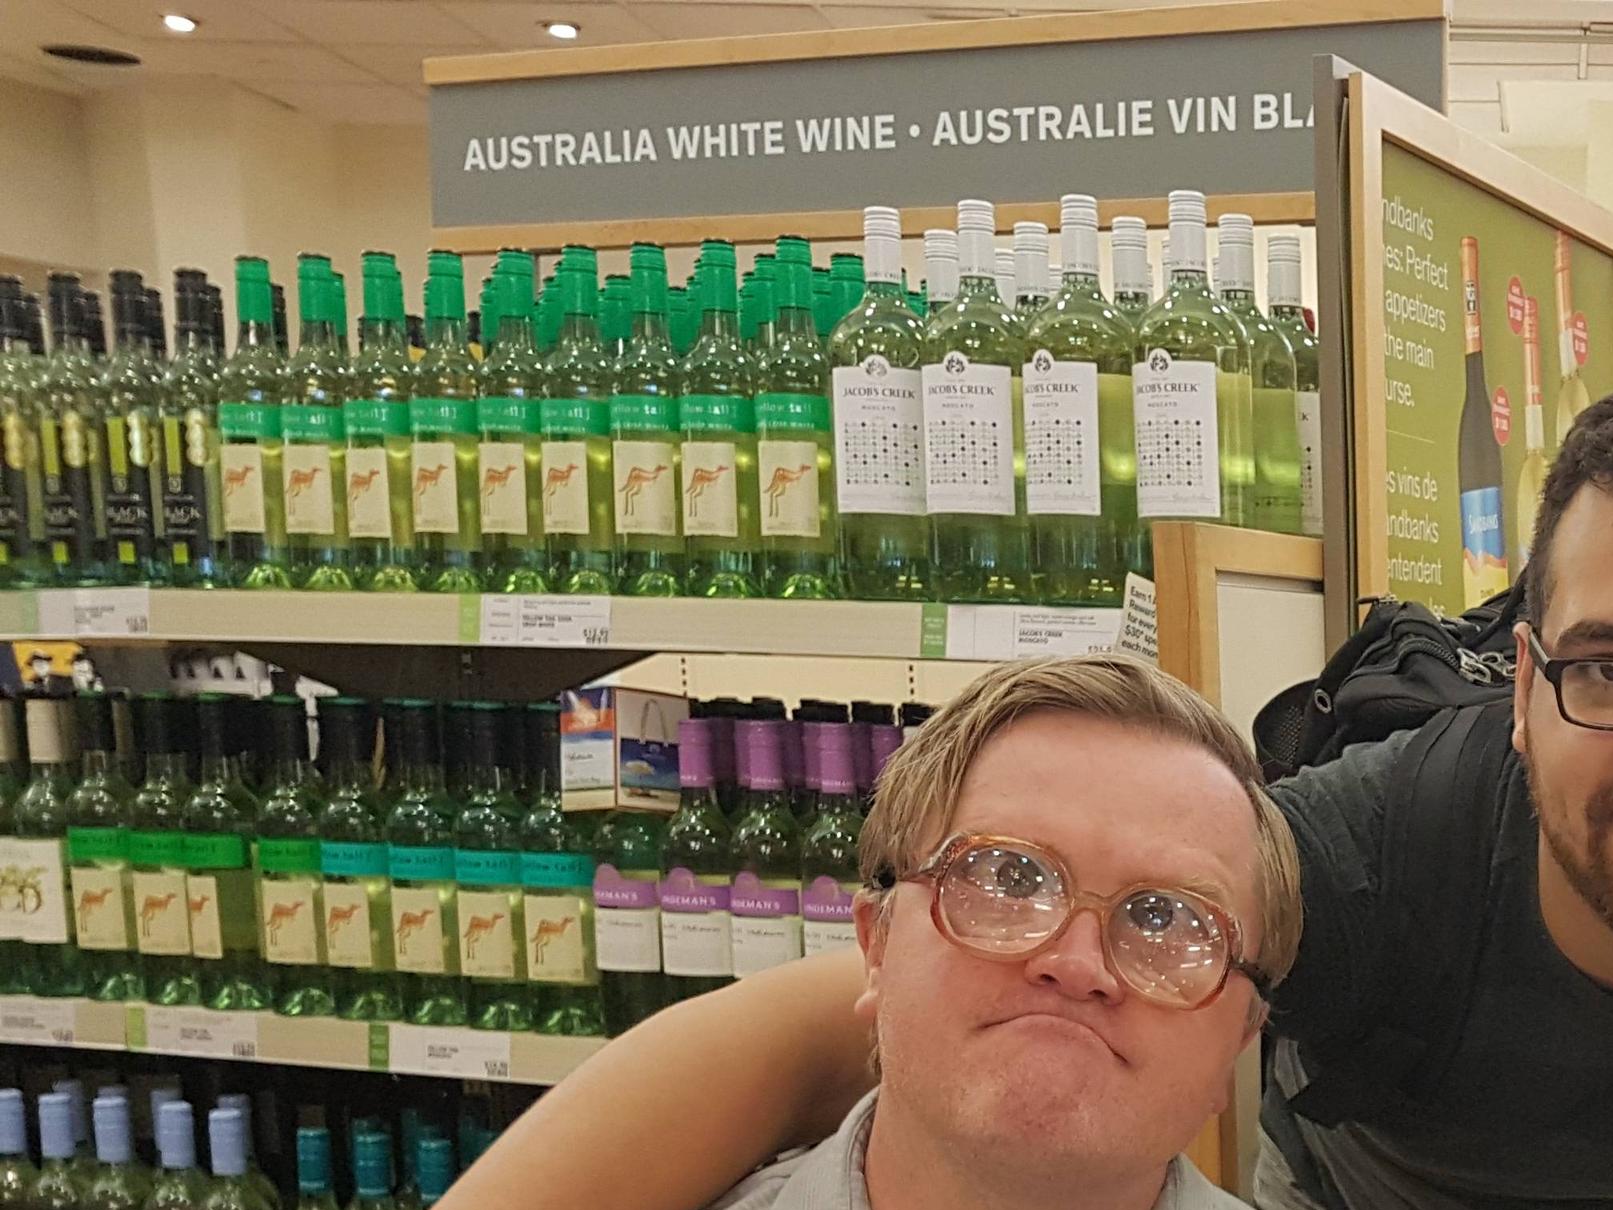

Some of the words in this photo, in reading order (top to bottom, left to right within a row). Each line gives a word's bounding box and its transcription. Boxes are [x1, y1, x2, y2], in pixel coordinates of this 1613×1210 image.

[463, 129, 657, 171] AUSTRALIA
[666, 120, 786, 160] WHITE
[796, 114, 896, 152] WINE
[931, 99, 1154, 146] AUSTRALIE
[1167, 94, 1238, 133] VIN
[1383, 195, 1434, 241] ndbanks
[1406, 245, 1448, 290] Perfect
[1385, 289, 1446, 333] appetizers
[1384, 325, 1403, 360] the
[1406, 339, 1434, 369] main
[960, 385, 995, 396] CREEK
[1046, 384, 1080, 394] CREEK
[1164, 383, 1198, 393] CREEK
[1385, 377, 1415, 407] urse.
[1399, 466, 1421, 498] vins
[1422, 472, 1438, 501] de
[1387, 509, 1439, 544] ndbanks
[1130, 586, 1146, 601] Earn
[1121, 639, 1141, 652] each
[1142, 647, 1158, 659] mon
